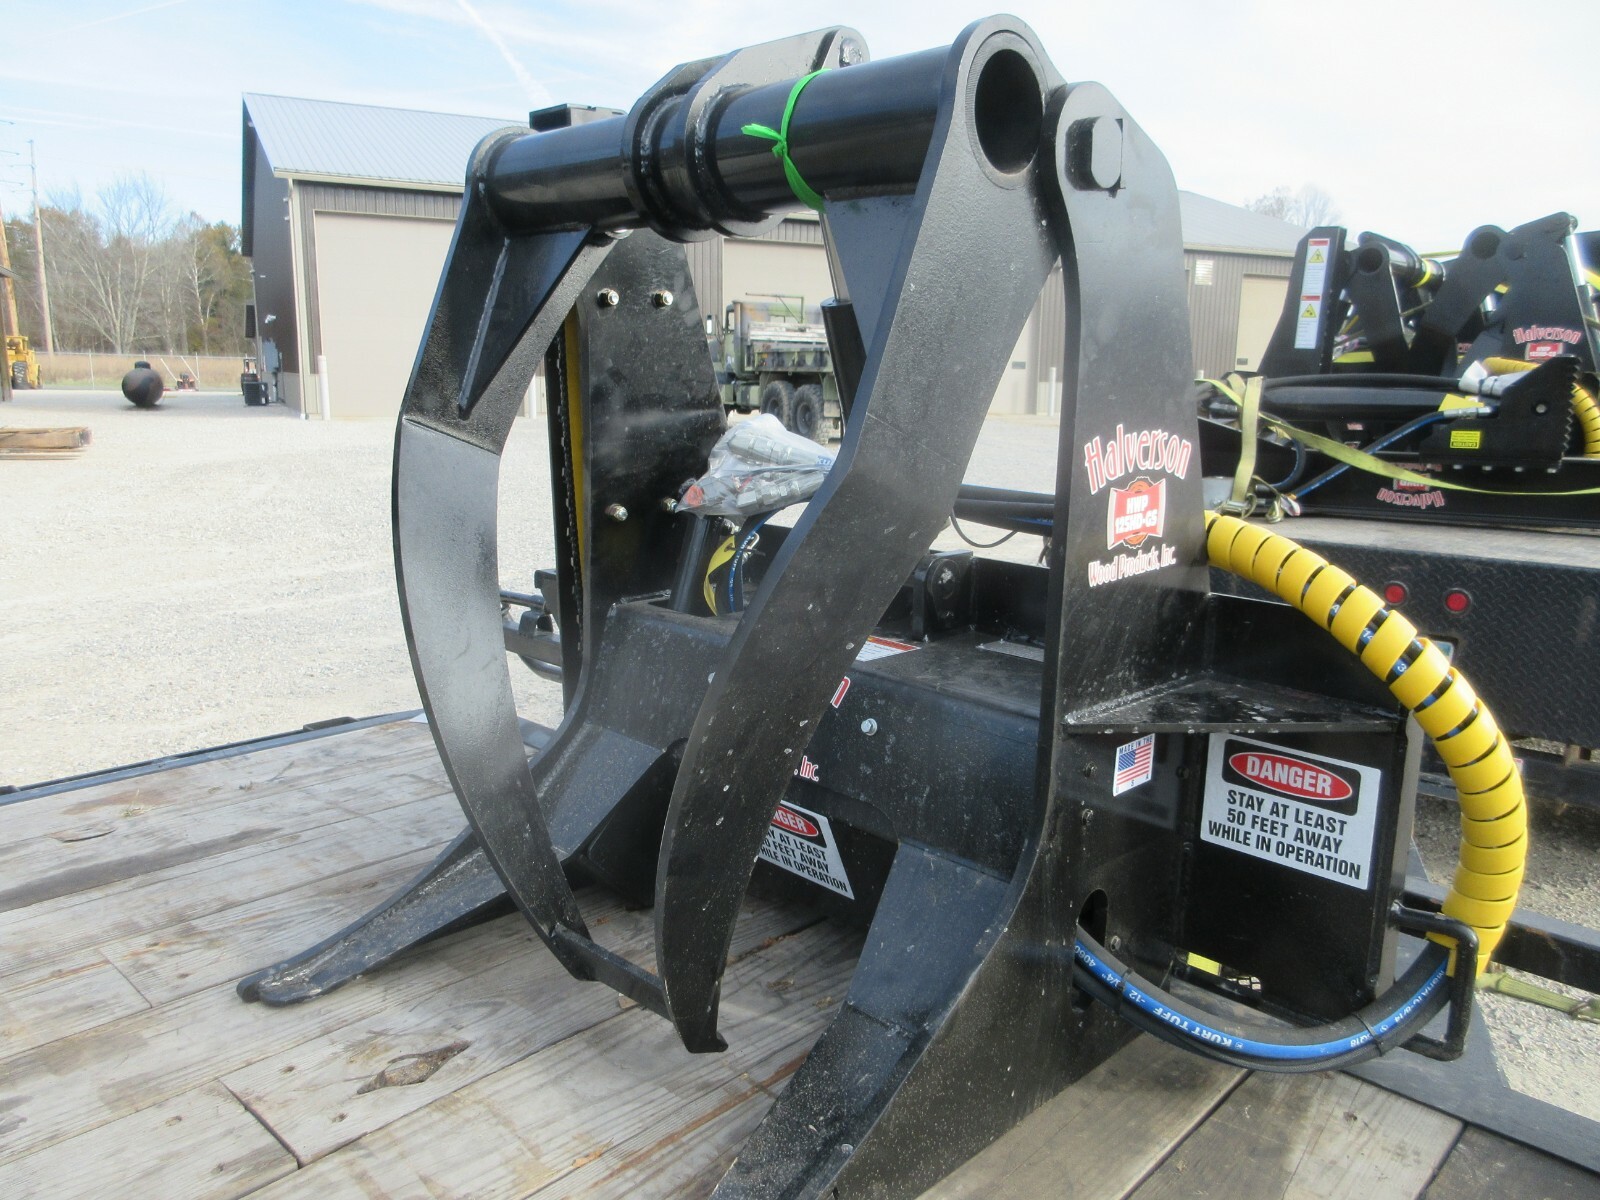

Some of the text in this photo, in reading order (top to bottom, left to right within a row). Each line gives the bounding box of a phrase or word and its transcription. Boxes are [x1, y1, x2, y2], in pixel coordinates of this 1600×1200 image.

[1513, 325, 1581, 344] Halverson
[1085, 424, 1192, 495] Halverson
[1126, 495, 1149, 514] HWP
[1377, 488, 1445, 509] Halverson
[1088, 543, 1176, 587] Wood Products, Inc.
[800, 755, 819, 782] Inc.
[1246, 755, 1332, 796] DANGER
[773, 809, 808, 833] NGER
[1227, 789, 1348, 836] STAY AT LEAST
[1227, 808, 1343, 855] 50 FEET AWAY
[772, 841, 797, 859] FEET
[800, 852, 829, 874] AWAY
[779, 832, 791, 846] AT
[793, 839, 827, 861] LEAST
[1208, 820, 1361, 880] WHILE IN OPERATION
[760, 846, 848, 892] HILE IN OPERATION
[1128, 989, 1146, 1003] -12
[1153, 1007, 1189, 1031] TUFF
[1191, 1026, 1232, 1047] KURT
